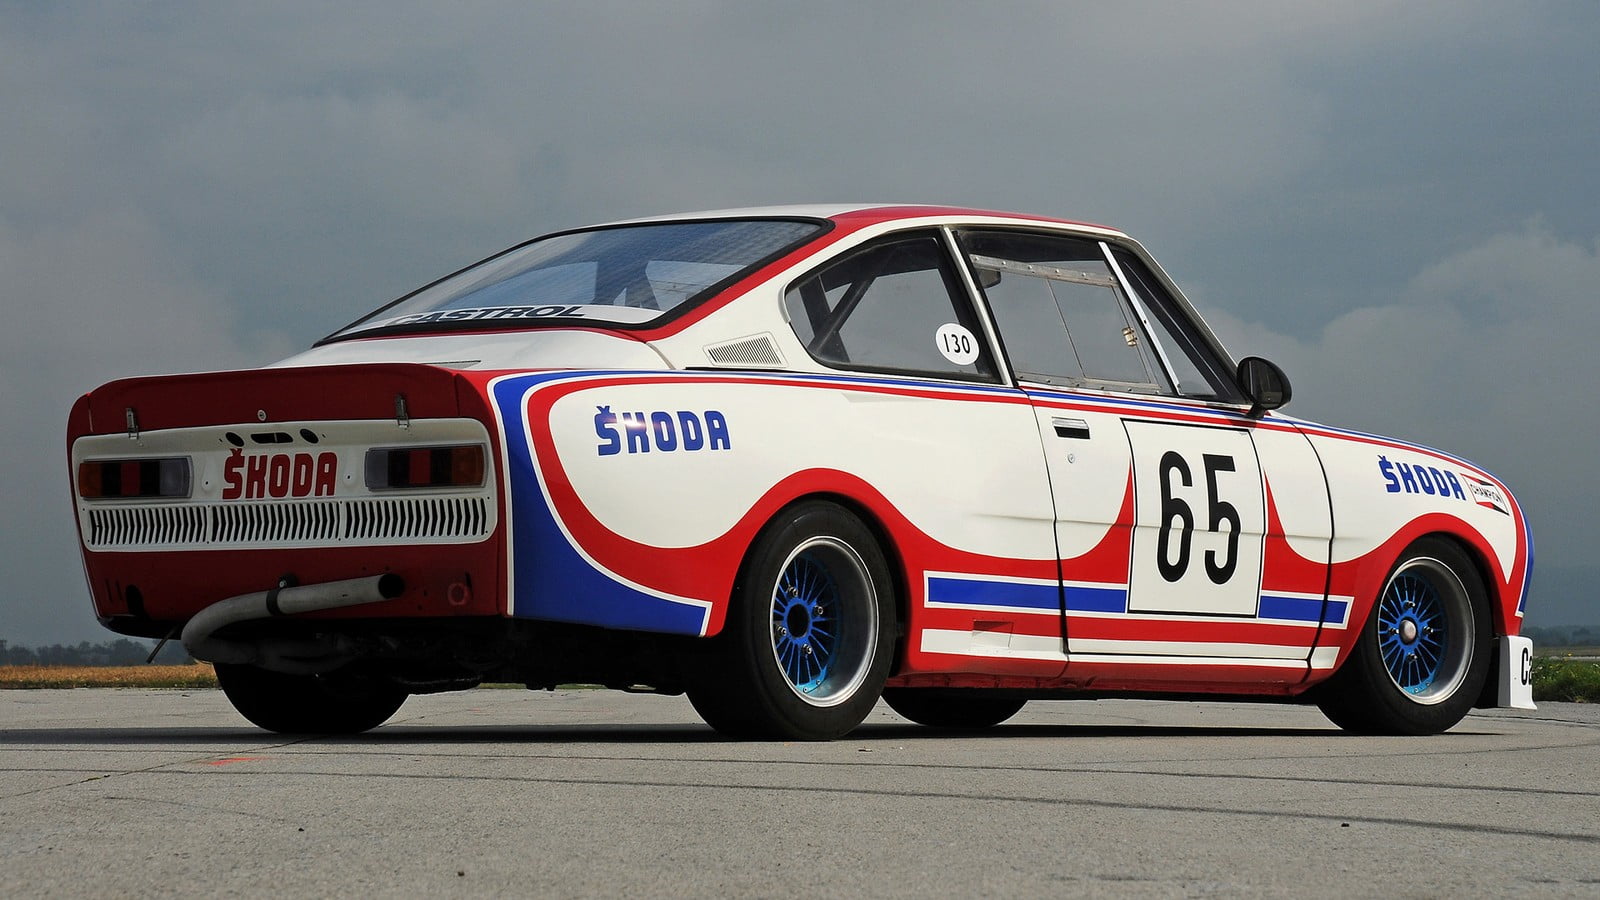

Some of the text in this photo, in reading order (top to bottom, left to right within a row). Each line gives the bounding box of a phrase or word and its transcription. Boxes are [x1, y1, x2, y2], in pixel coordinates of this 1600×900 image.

[386, 306, 584, 325] CASTROL
[943, 333, 971, 354] 130
[594, 405, 731, 456] ŠKODA
[222, 448, 338, 499] ŠKODA
[1378, 455, 1467, 500] ŠKODA
[1157, 451, 1241, 585] 65
